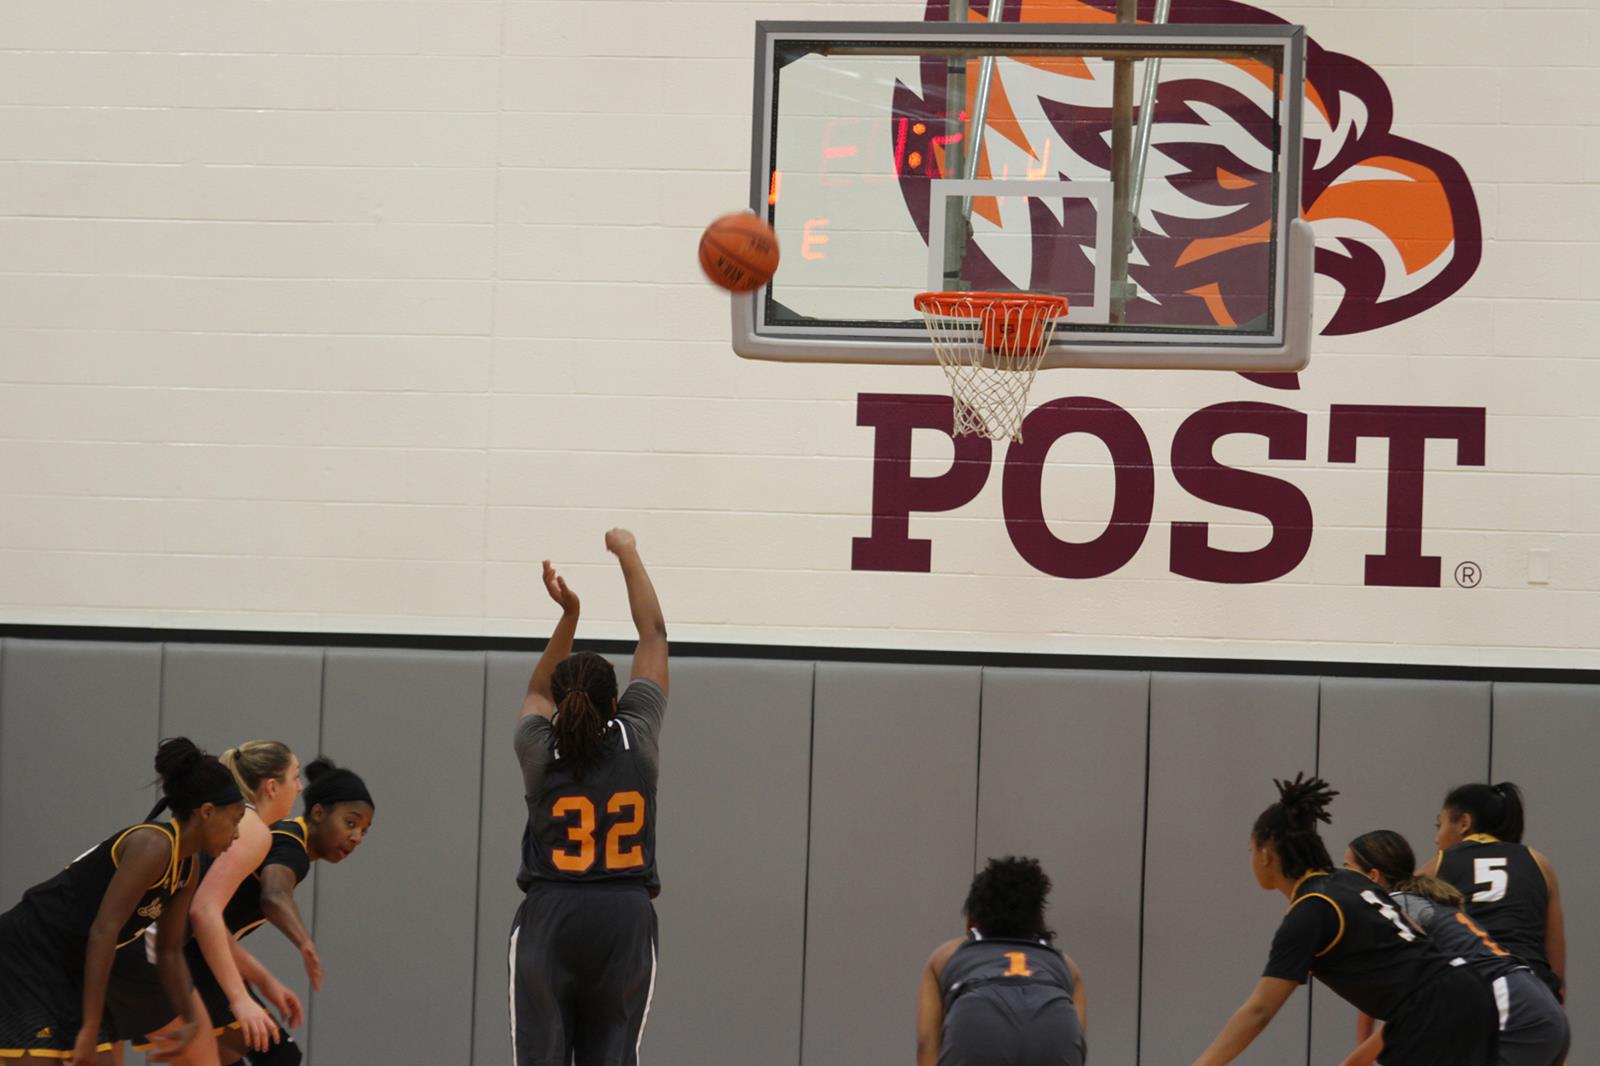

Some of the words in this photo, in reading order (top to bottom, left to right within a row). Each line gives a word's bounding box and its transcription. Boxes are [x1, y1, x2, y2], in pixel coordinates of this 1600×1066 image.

[851, 392, 1486, 587] POST
[551, 790, 646, 872] 32
[1471, 857, 1508, 903] 5
[1002, 951, 1033, 977] 1
